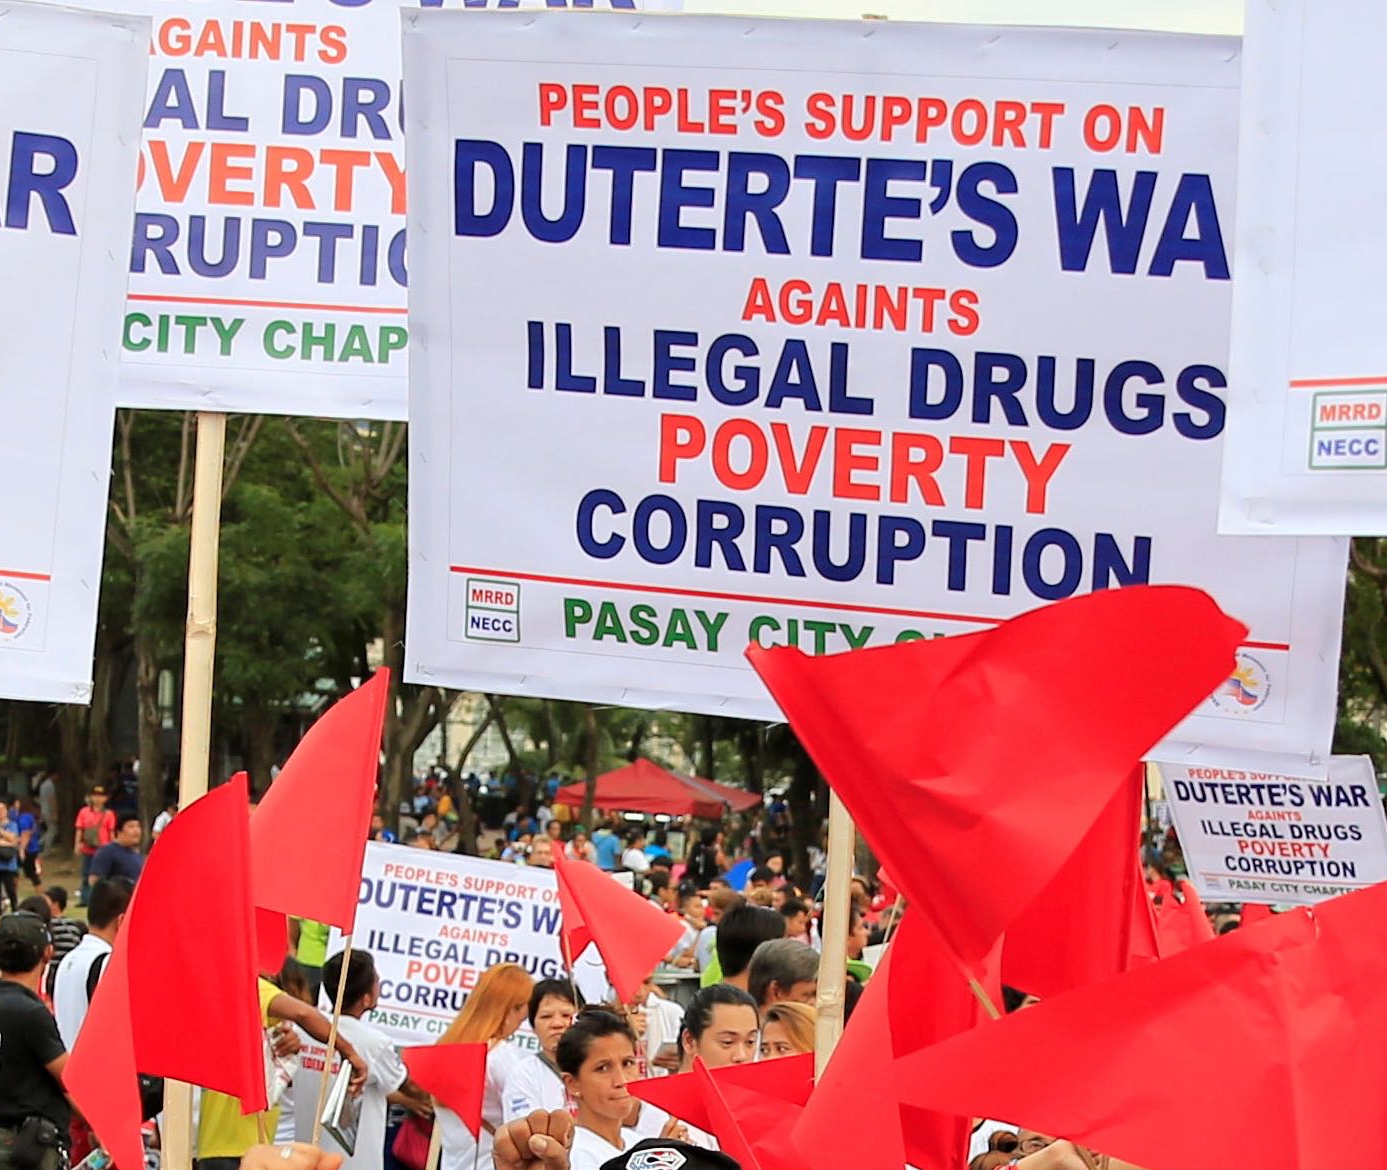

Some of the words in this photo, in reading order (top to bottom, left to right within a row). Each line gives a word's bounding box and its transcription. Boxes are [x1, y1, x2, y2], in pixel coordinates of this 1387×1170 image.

[148, 17, 348, 65] GAINTS
[538, 83, 787, 138] PEOPLE'S
[804, 92, 1064, 150] SUPPORT
[1082, 103, 1165, 155] ON
[137, 139, 407, 215] VERTY
[453, 138, 1020, 268] DUTERTE'S
[129, 212, 408, 288] RUPTI
[741, 276, 980, 336] AGAINTS
[121, 312, 245, 356] CITY
[526, 320, 875, 416] ILLEGAL
[909, 346, 1227, 441] DRUGS
[1319, 402, 1381, 421] MRRD
[658, 412, 1072, 515] POVERTY
[1316, 438, 1379, 458] NECC
[575, 488, 1152, 600] CORRUPTION
[471, 588, 514, 607] MRRD
[470, 615, 513, 633] NECC
[564, 597, 729, 653] PASAY
[1173, 780, 1303, 807] DUTERTE'S
[1309, 784, 1370, 808] WAR
[1201, 819, 1284, 839] ILLEGAL
[1290, 823, 1362, 841] DRUGS
[1247, 810, 1302, 822] AGAINTS
[1237, 839, 1331, 860] POVERTY
[384, 863, 458, 887] PEOPLE'S
[463, 876, 538, 899] SUPPORT
[1225, 855, 1356, 879] CORRUPTION
[1228, 878, 1267, 891] PASAY
[1271, 881, 1299, 894] CITY
[368, 929, 474, 965] ILLEGAL
[438, 924, 509, 947] AGAINTS
[406, 959, 479, 989] POVE
[368, 1009, 421, 1029] PASAY
